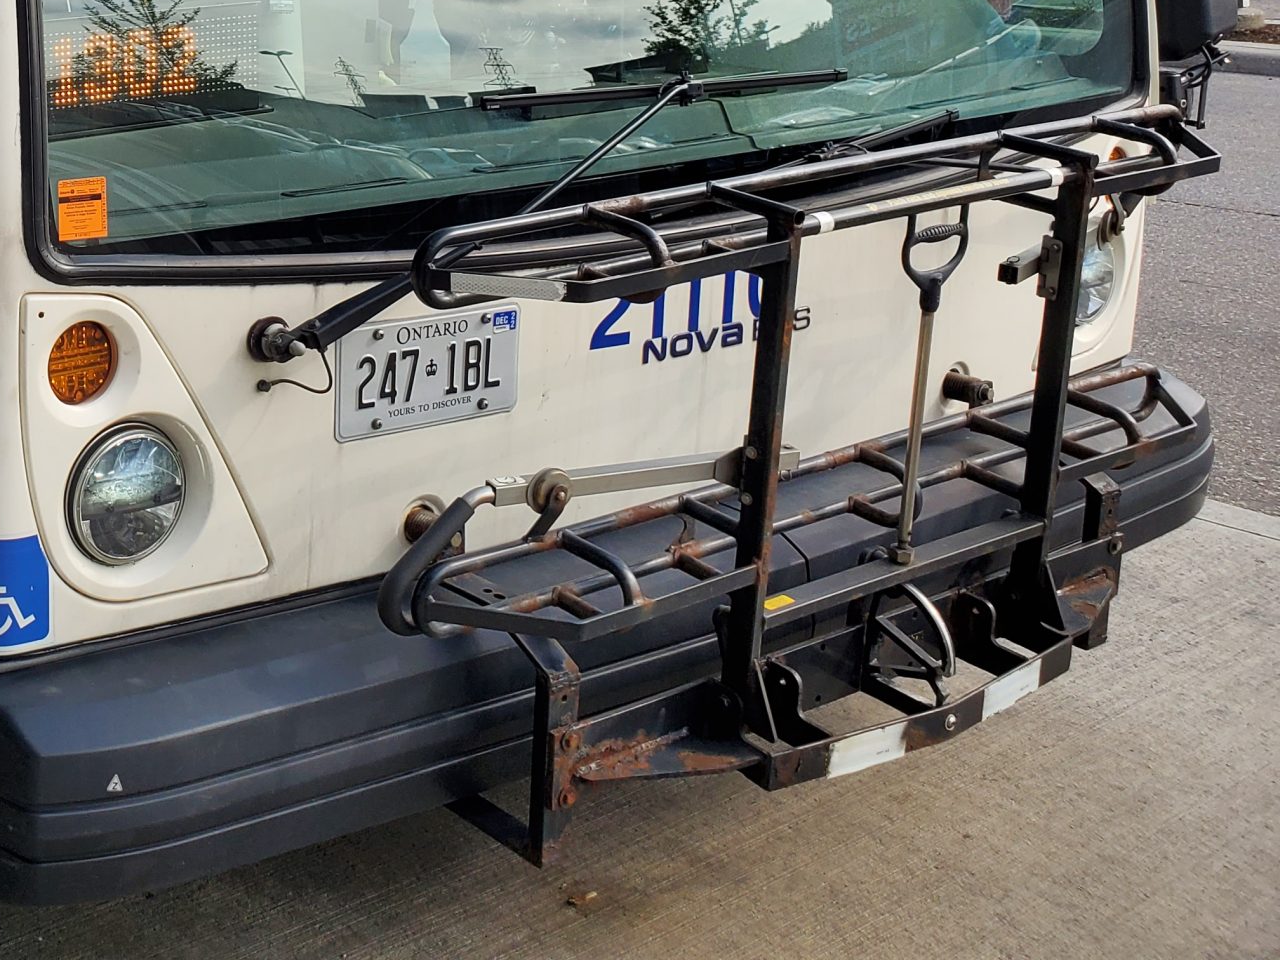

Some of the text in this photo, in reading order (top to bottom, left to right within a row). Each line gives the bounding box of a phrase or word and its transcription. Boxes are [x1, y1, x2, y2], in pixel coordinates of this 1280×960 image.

[53, 24, 197, 105] 1302
[397, 320, 468, 344] ONTARIO
[495, 315, 509, 325] DEC
[358, 336, 500, 410] 247 1BL
[388, 395, 472, 418] YOURS TO DISCOVER
